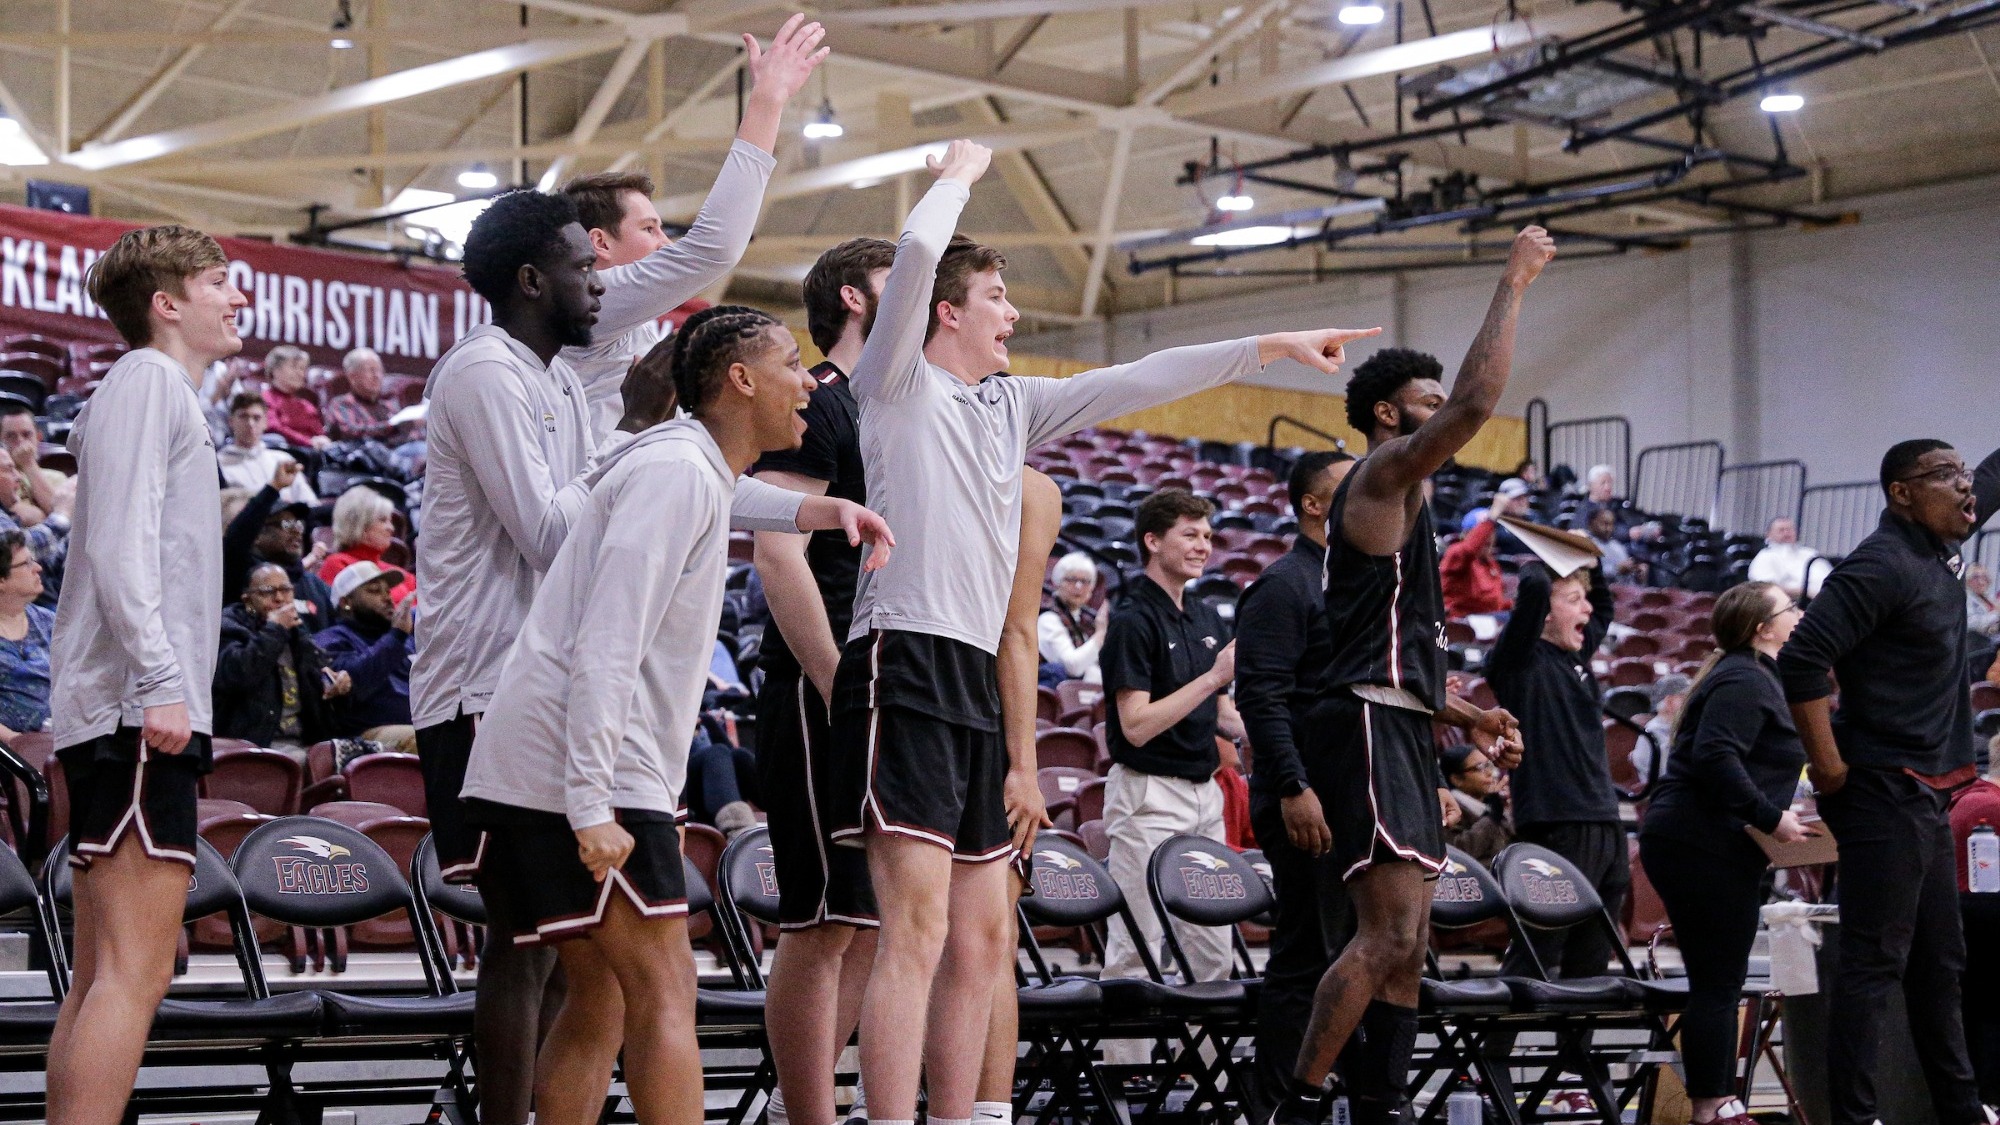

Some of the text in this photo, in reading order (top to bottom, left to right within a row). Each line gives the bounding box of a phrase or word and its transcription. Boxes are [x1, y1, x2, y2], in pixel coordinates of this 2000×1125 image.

[228, 259, 440, 360] CHRISTIAN
[272, 855, 370, 895] EAGLES
[1033, 867, 1099, 900] EAGLES
[1179, 867, 1246, 900] EAGLES
[1433, 876, 1483, 902] AGLES
[1520, 873, 1579, 904] EAGLES
